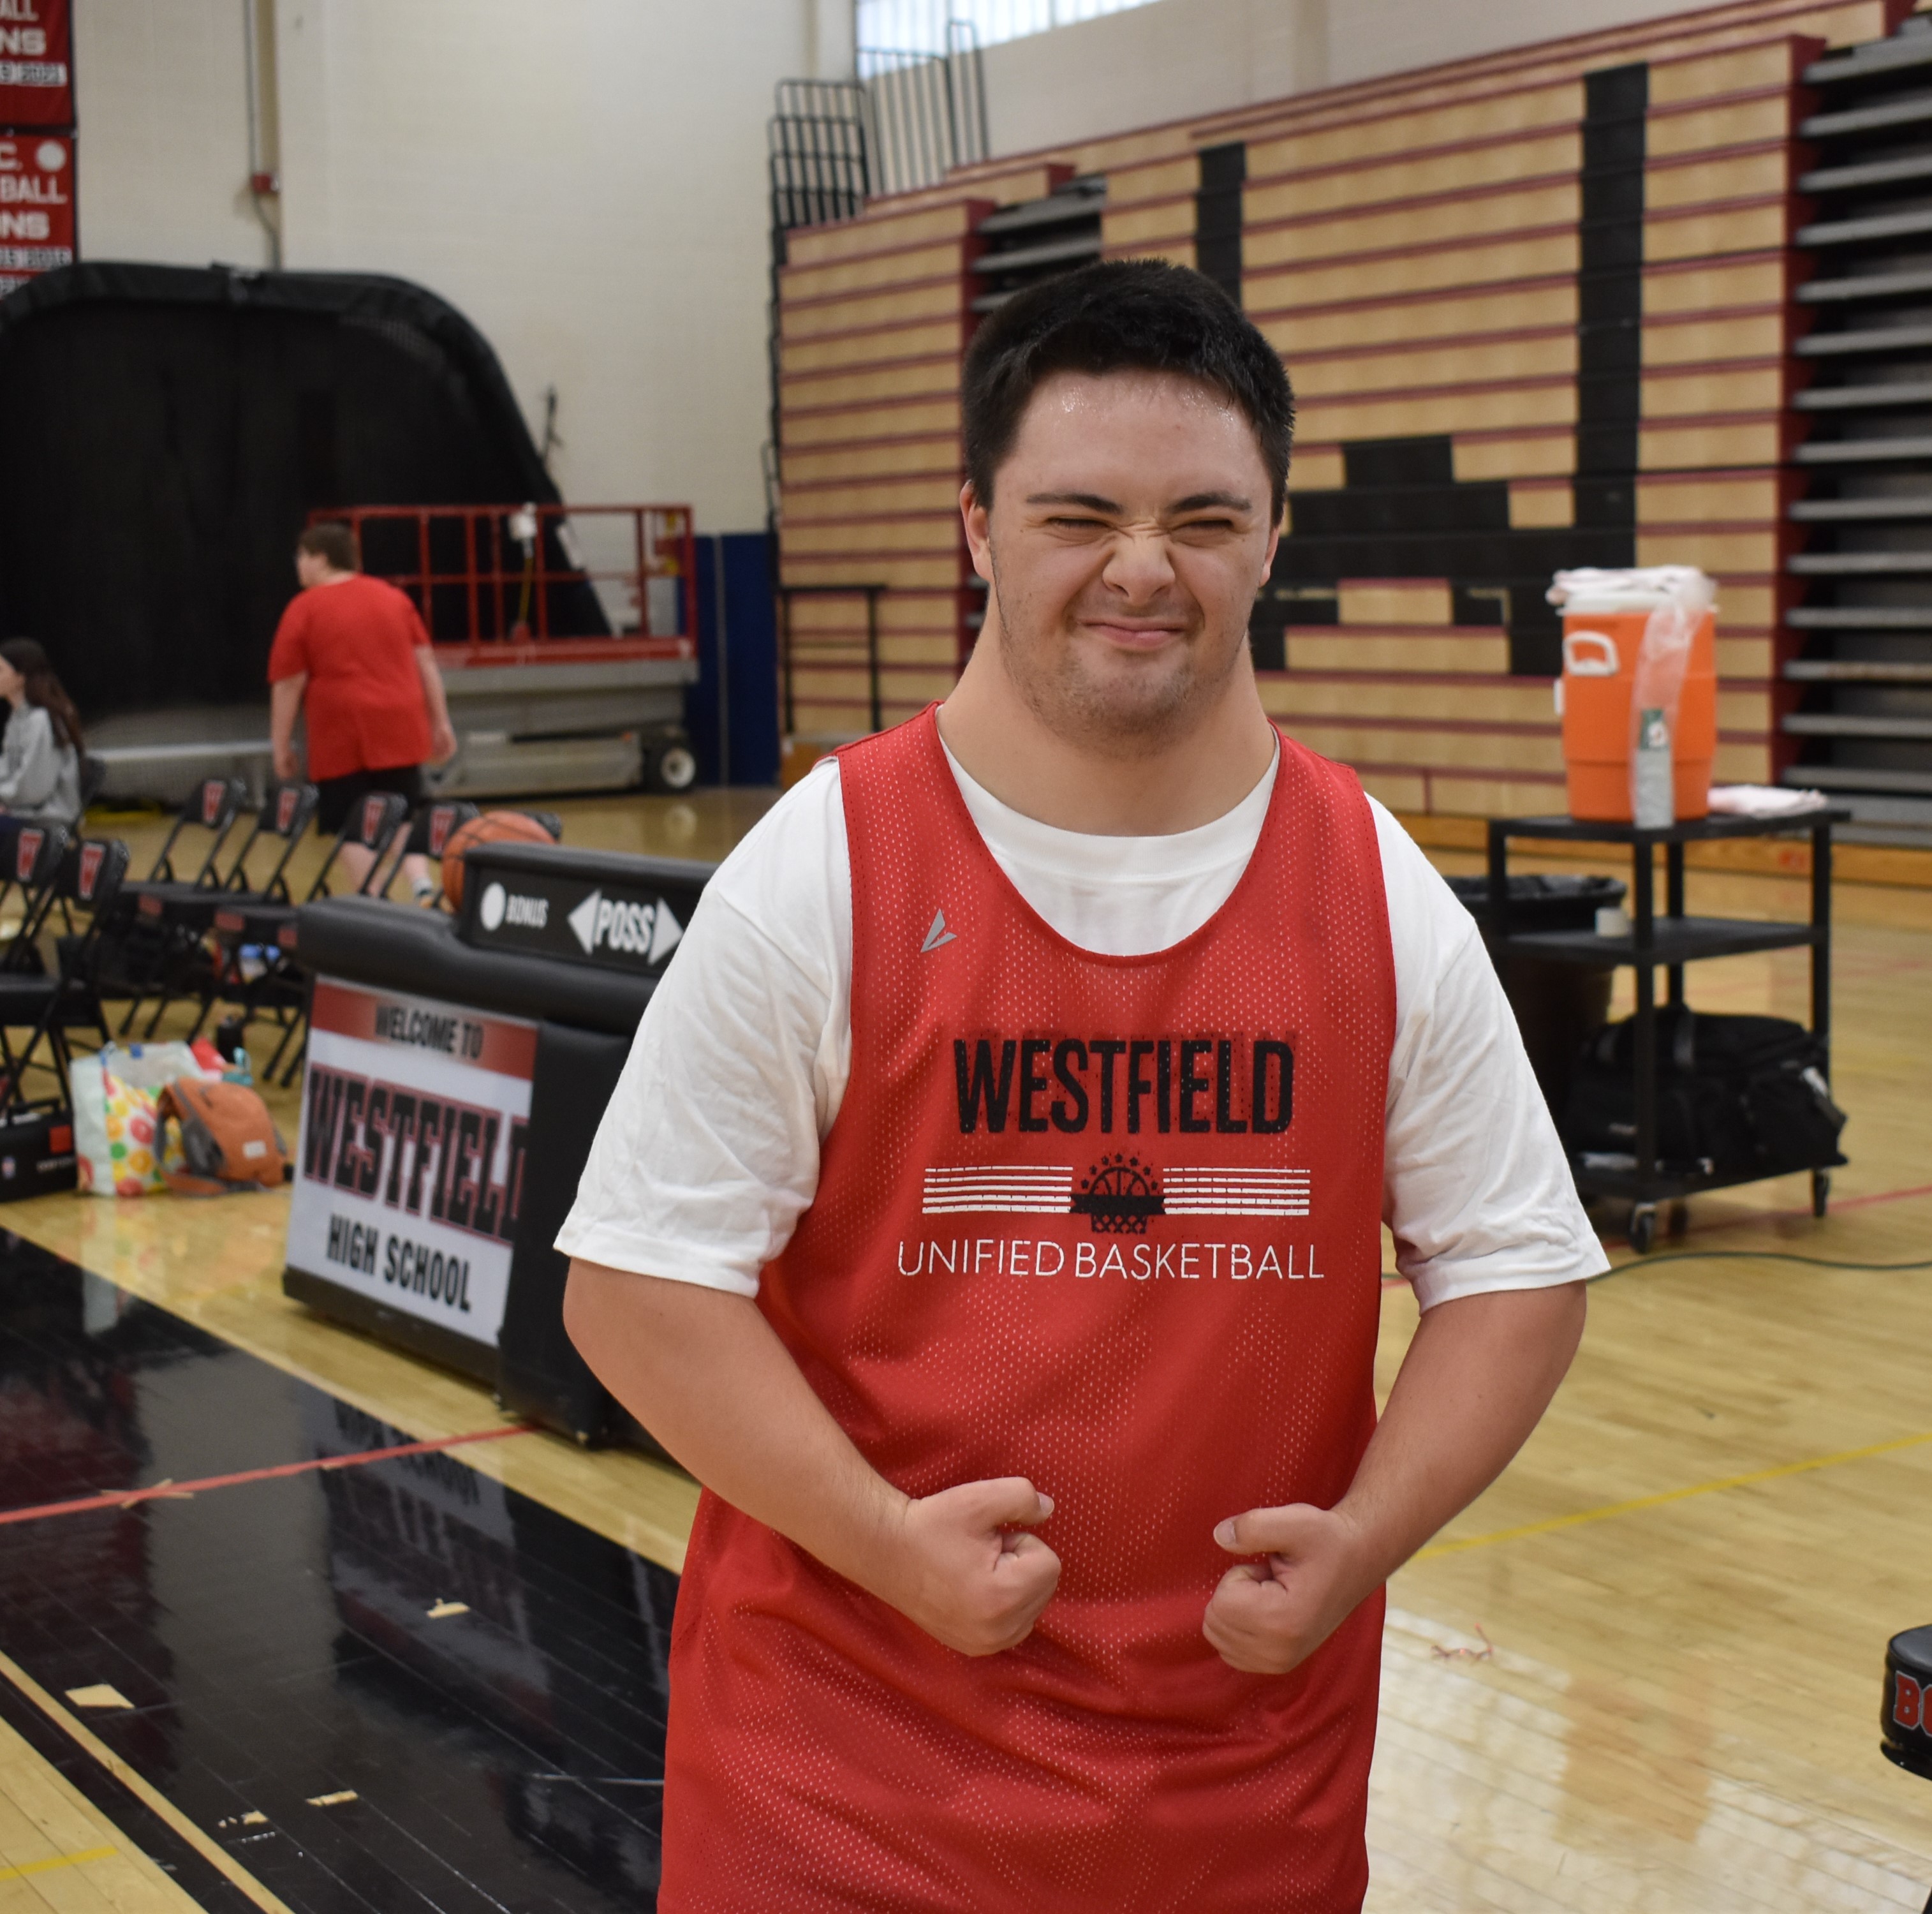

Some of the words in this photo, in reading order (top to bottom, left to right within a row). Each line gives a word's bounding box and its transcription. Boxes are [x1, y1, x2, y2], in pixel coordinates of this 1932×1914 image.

[506, 894, 550, 928] BONUS
[593, 898, 656, 954] POSS
[374, 1004, 458, 1054] WELCOME
[461, 1021, 484, 1060] TO
[953, 1039, 1295, 1134] WESTFIELD
[327, 1213, 379, 1275] HIGH
[384, 1233, 471, 1312] SCHOOL
[897, 1238, 1065, 1277] UNIFIED
[1075, 1242, 1325, 1280] BASKETBALL
